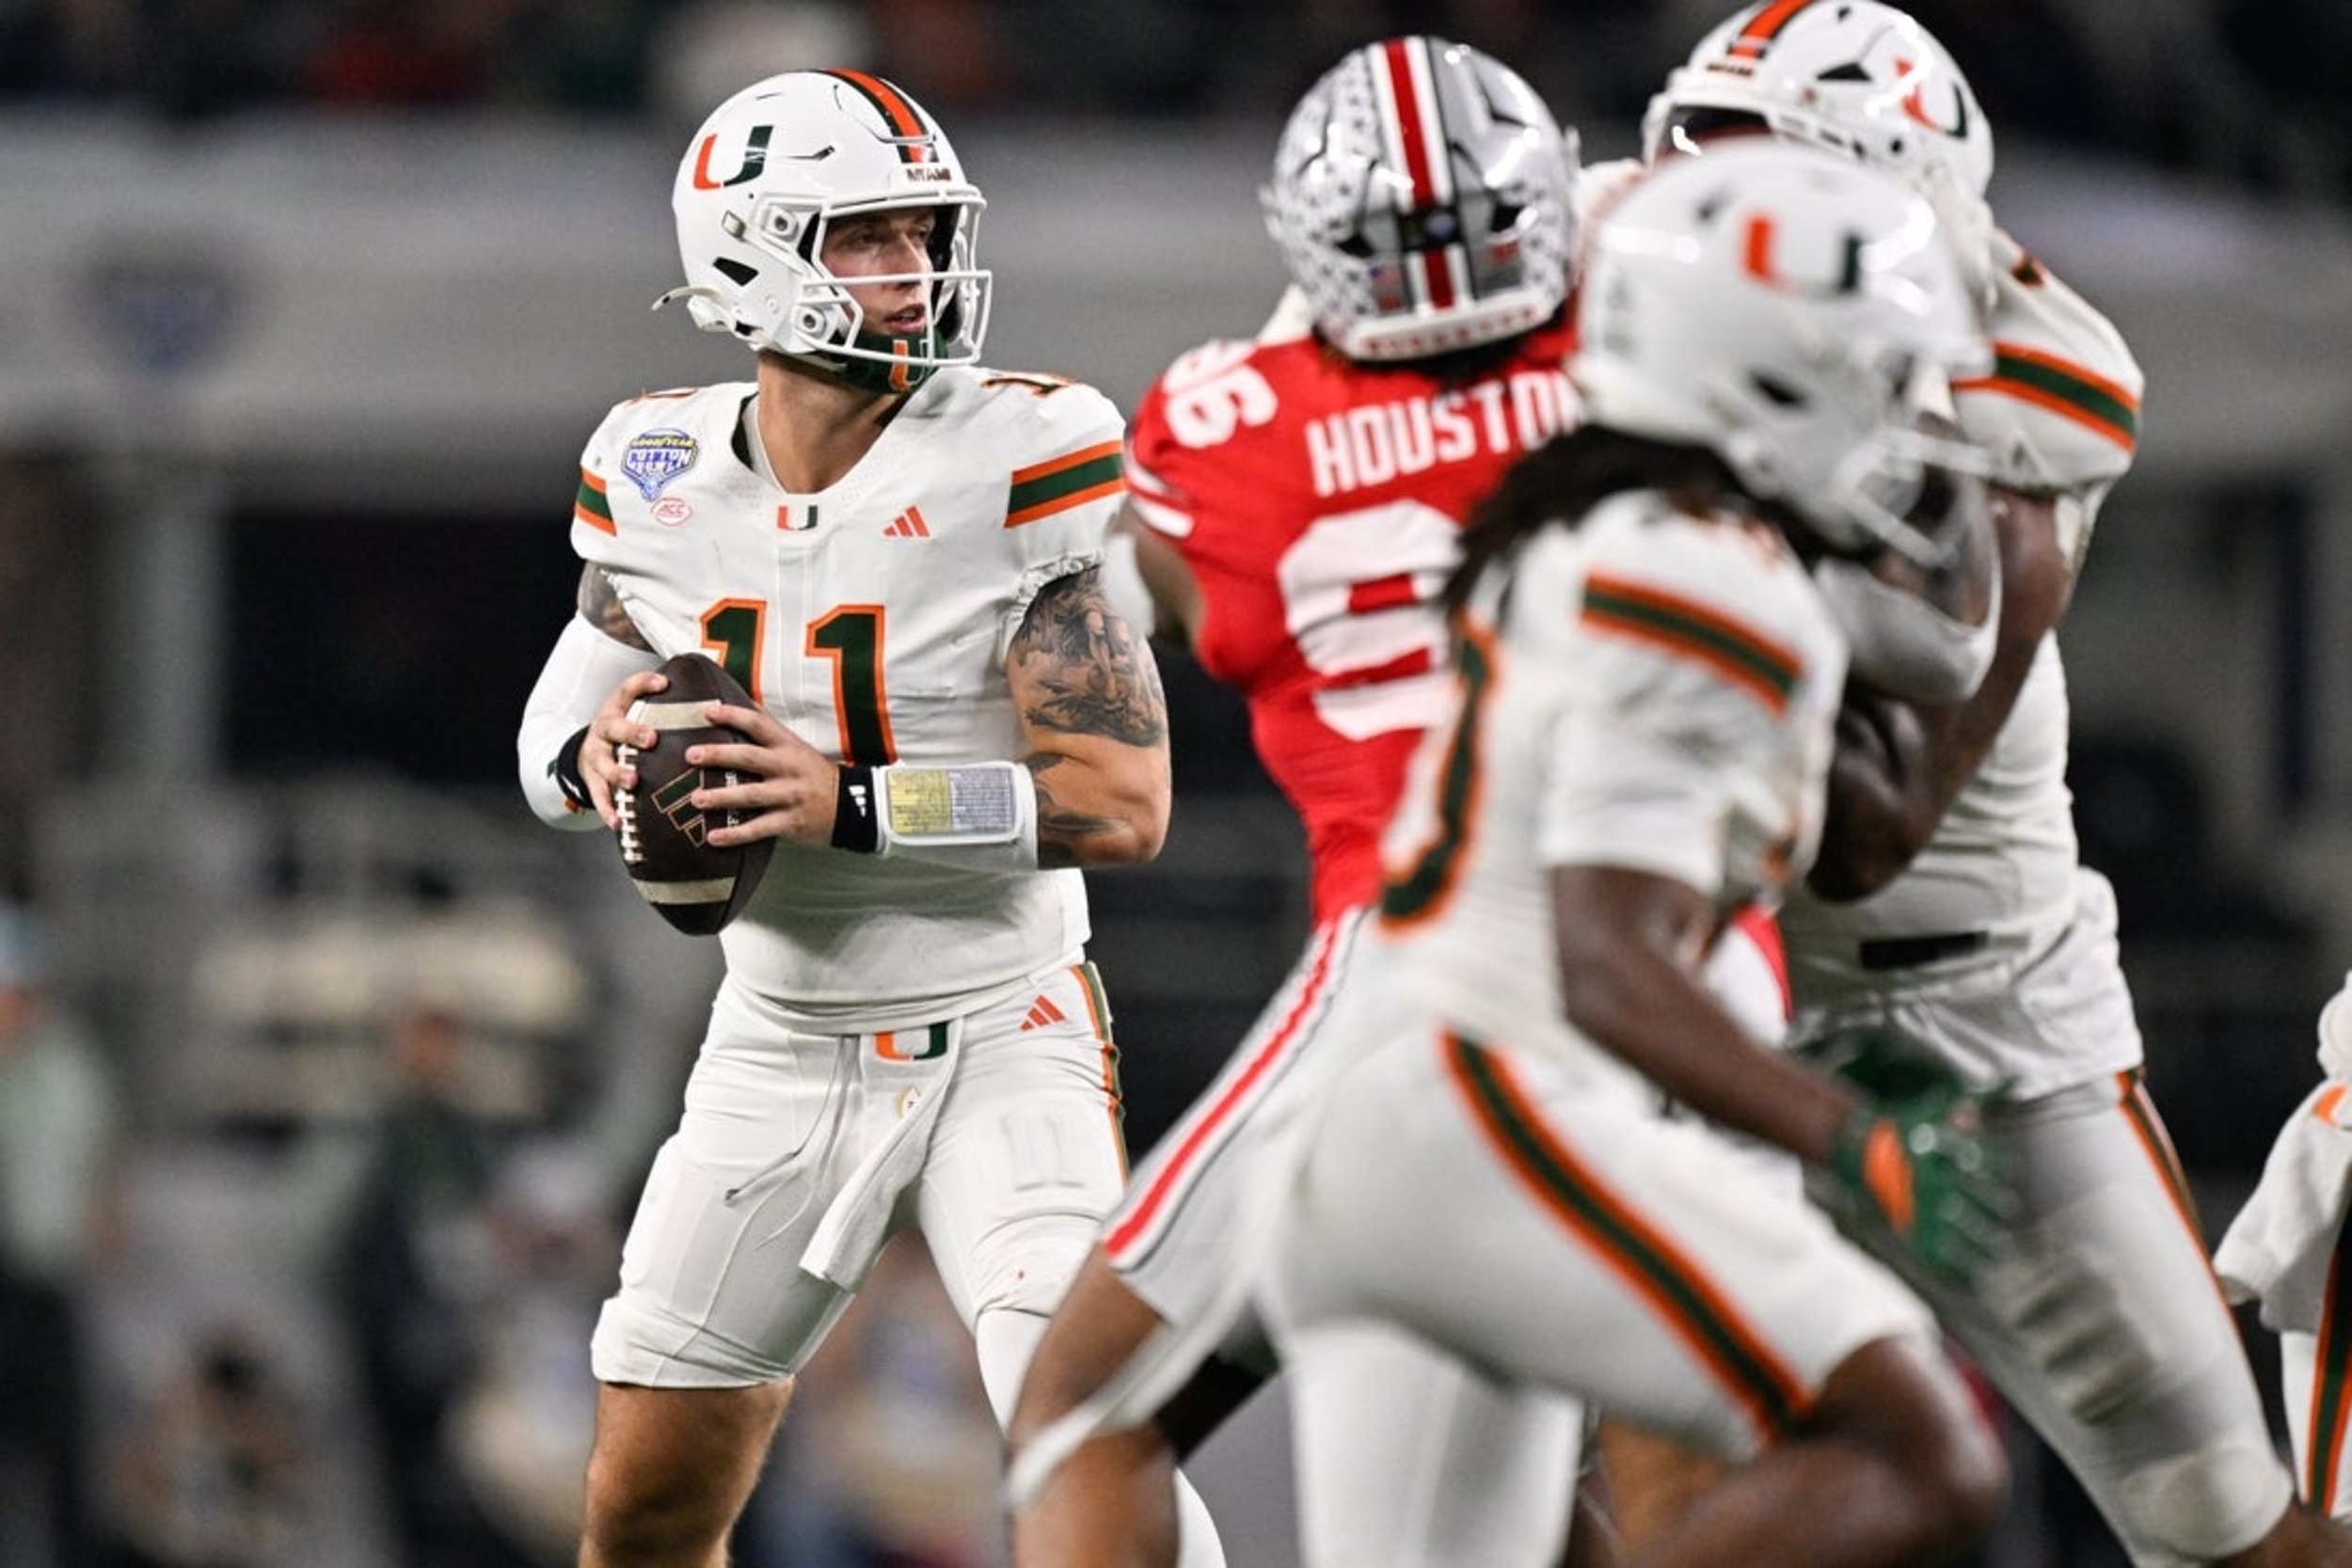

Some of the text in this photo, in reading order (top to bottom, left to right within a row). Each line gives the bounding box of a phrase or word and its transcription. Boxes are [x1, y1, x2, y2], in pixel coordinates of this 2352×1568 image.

[693, 125, 773, 190] U
[906, 167, 951, 182] MIAMI
[1740, 210, 1863, 293] U
[776, 505, 818, 531] U
[699, 598, 898, 766] 11
[873, 1021, 950, 1062] U
